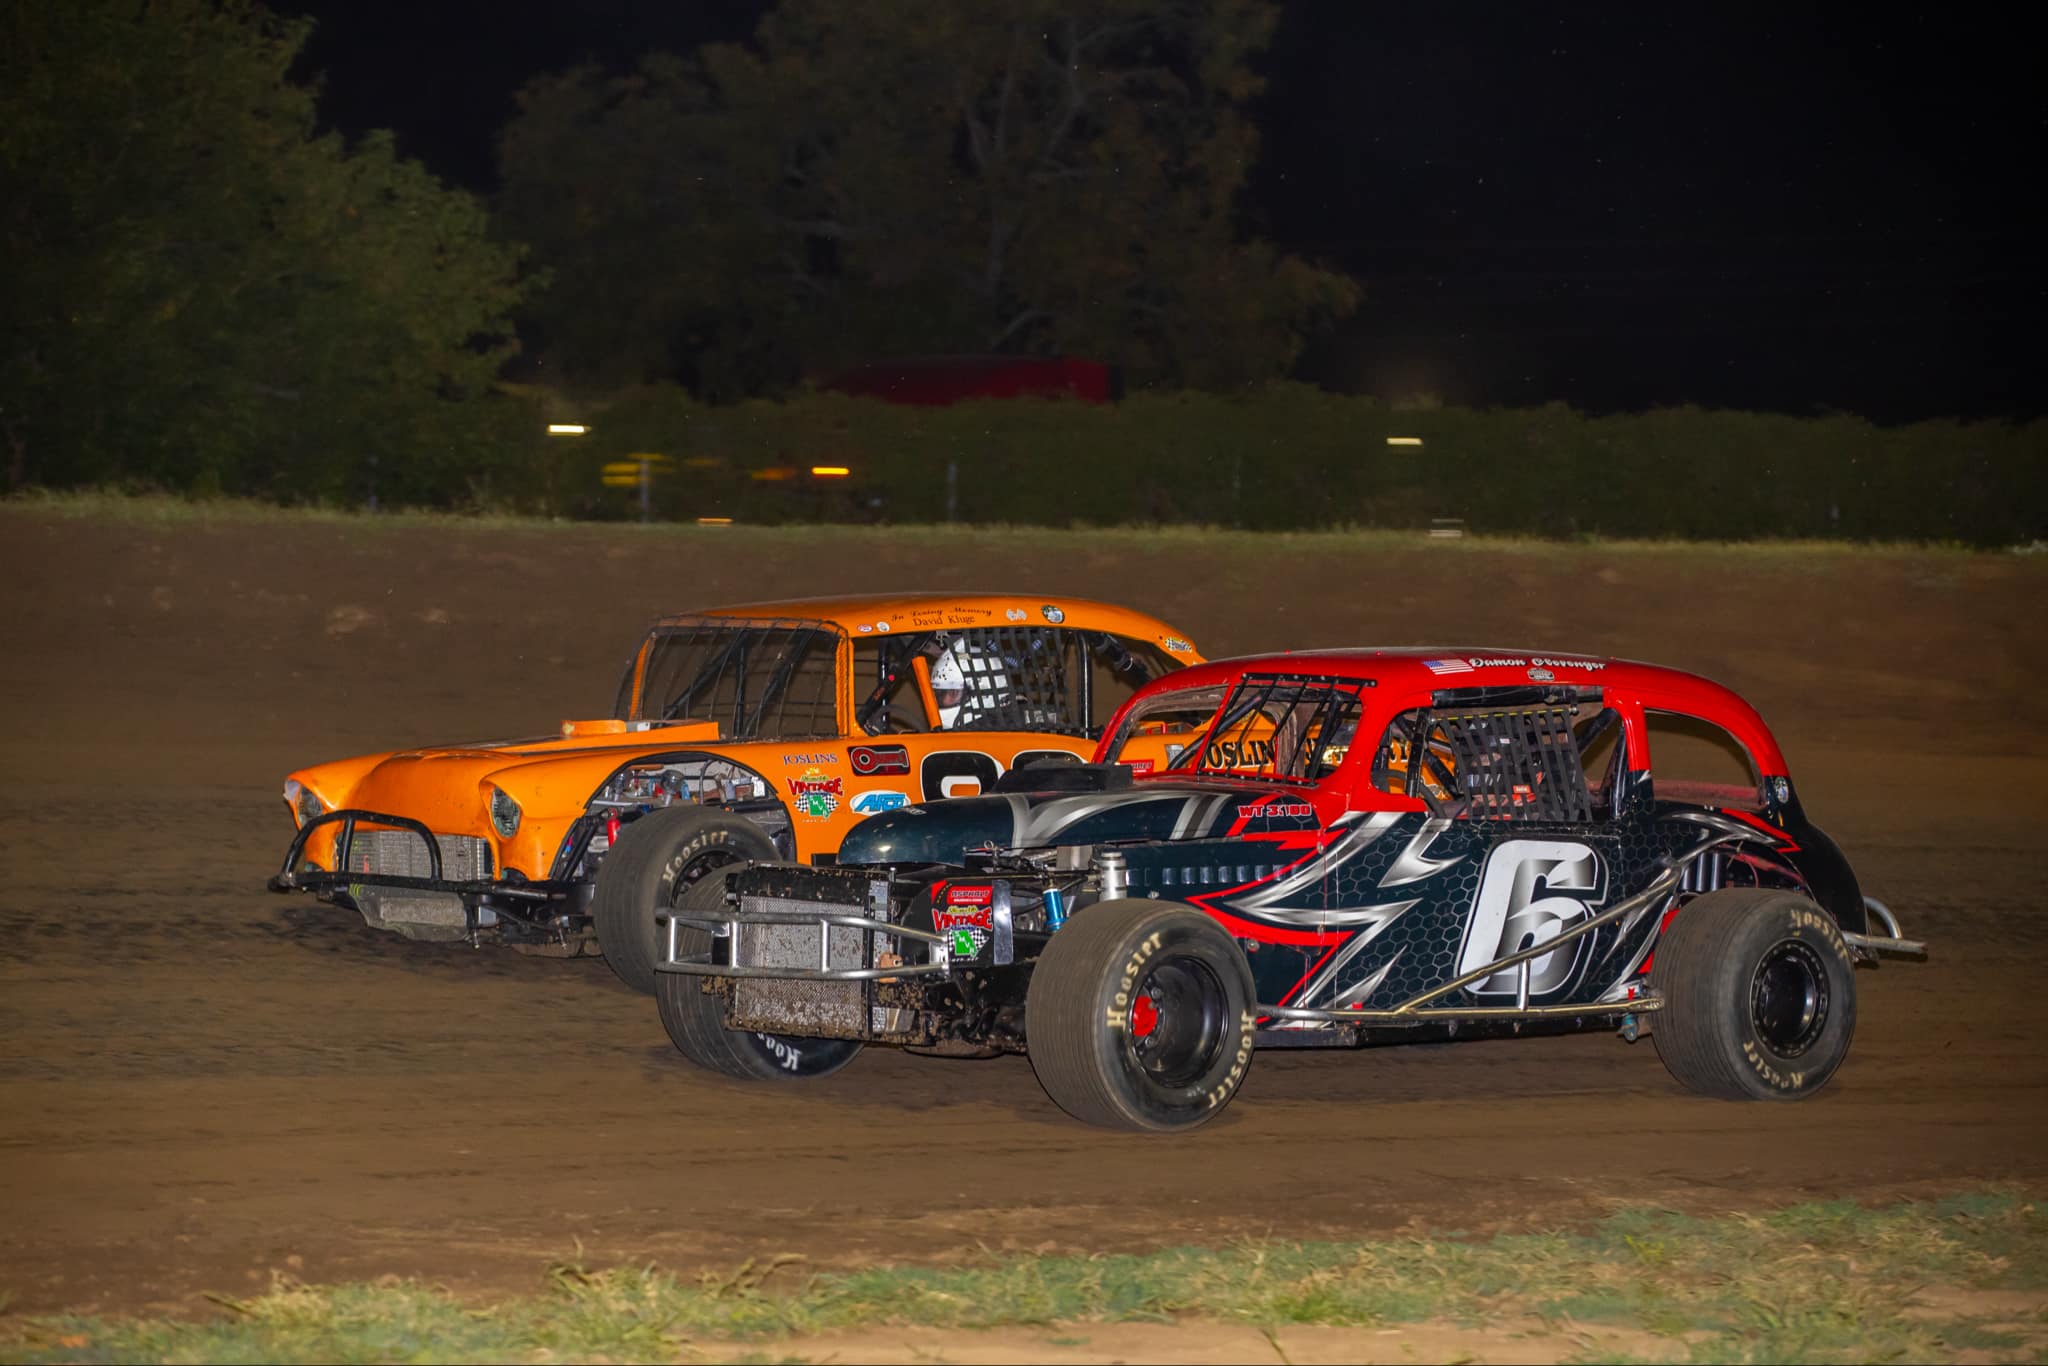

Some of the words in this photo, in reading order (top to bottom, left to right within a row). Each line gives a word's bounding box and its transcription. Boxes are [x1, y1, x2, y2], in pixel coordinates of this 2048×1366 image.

[913, 616, 943, 626] David
[947, 615, 976, 625] Kluge
[783, 752, 839, 766] JOSLINS
[787, 777, 843, 797] VINTAGE
[1237, 805, 1264, 818] WT
[931, 906, 993, 932] VINTAGE
[1458, 839, 1600, 996] 6
[1106, 932, 1161, 1032] Hoosier
[1208, 1010, 1257, 1108] Hoosier
